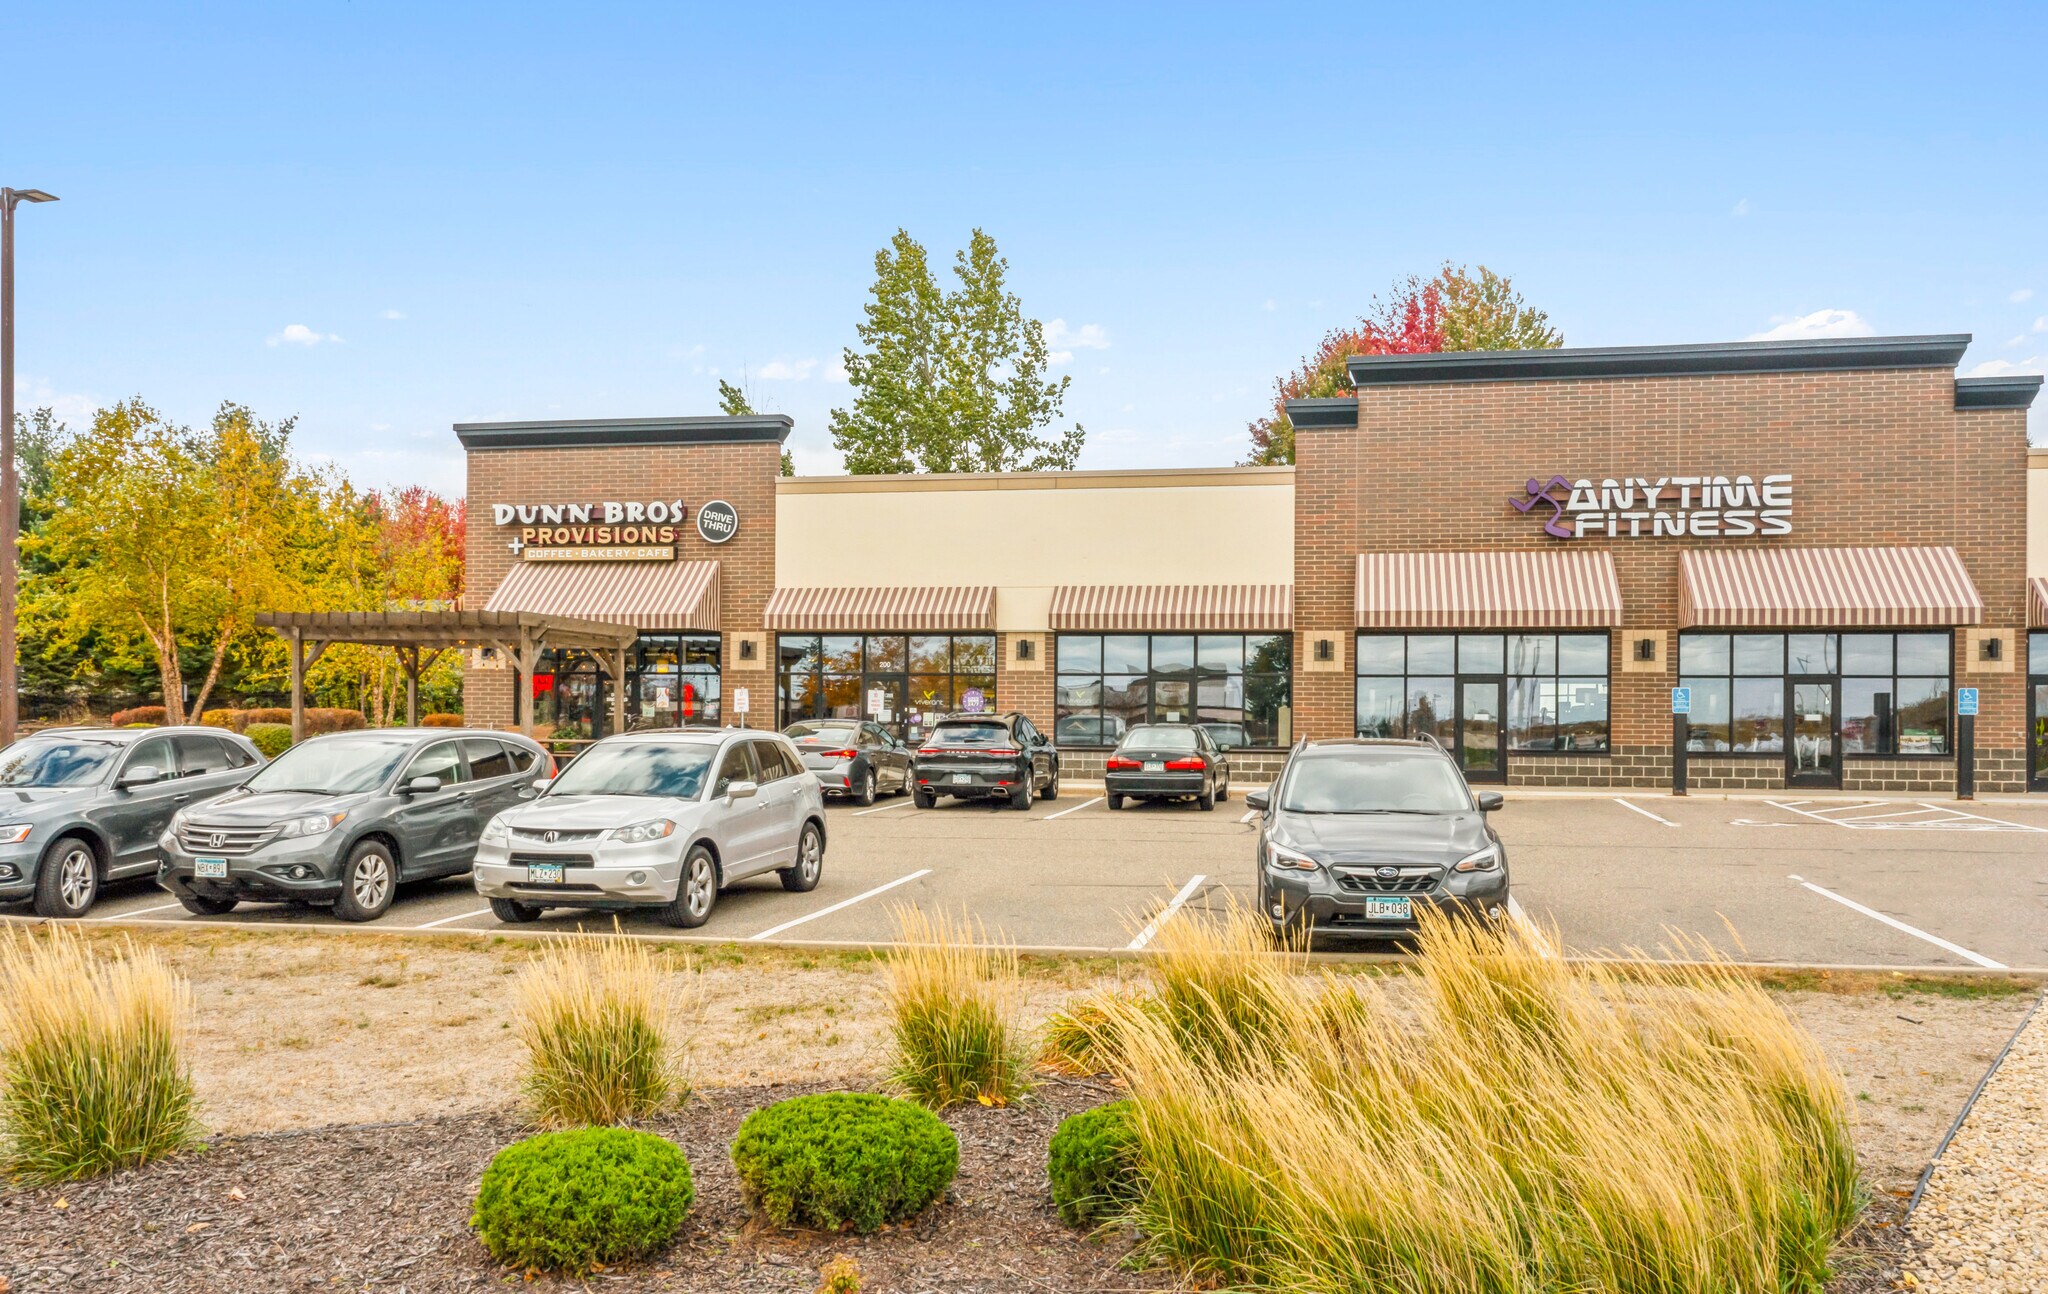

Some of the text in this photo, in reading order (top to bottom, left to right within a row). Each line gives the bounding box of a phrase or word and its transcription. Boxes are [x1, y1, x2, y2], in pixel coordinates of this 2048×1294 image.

[1565, 474, 1793, 511] ANYTIME
[492, 499, 684, 526] DUNN BROS
[702, 510, 734, 524] DRIVE
[702, 519, 732, 534] THRU
[1575, 509, 1793, 538] FITNESS
[522, 526, 676, 545] PROVISIONS
[528, 548, 669, 558] COFFEE BAKERY CAFE
